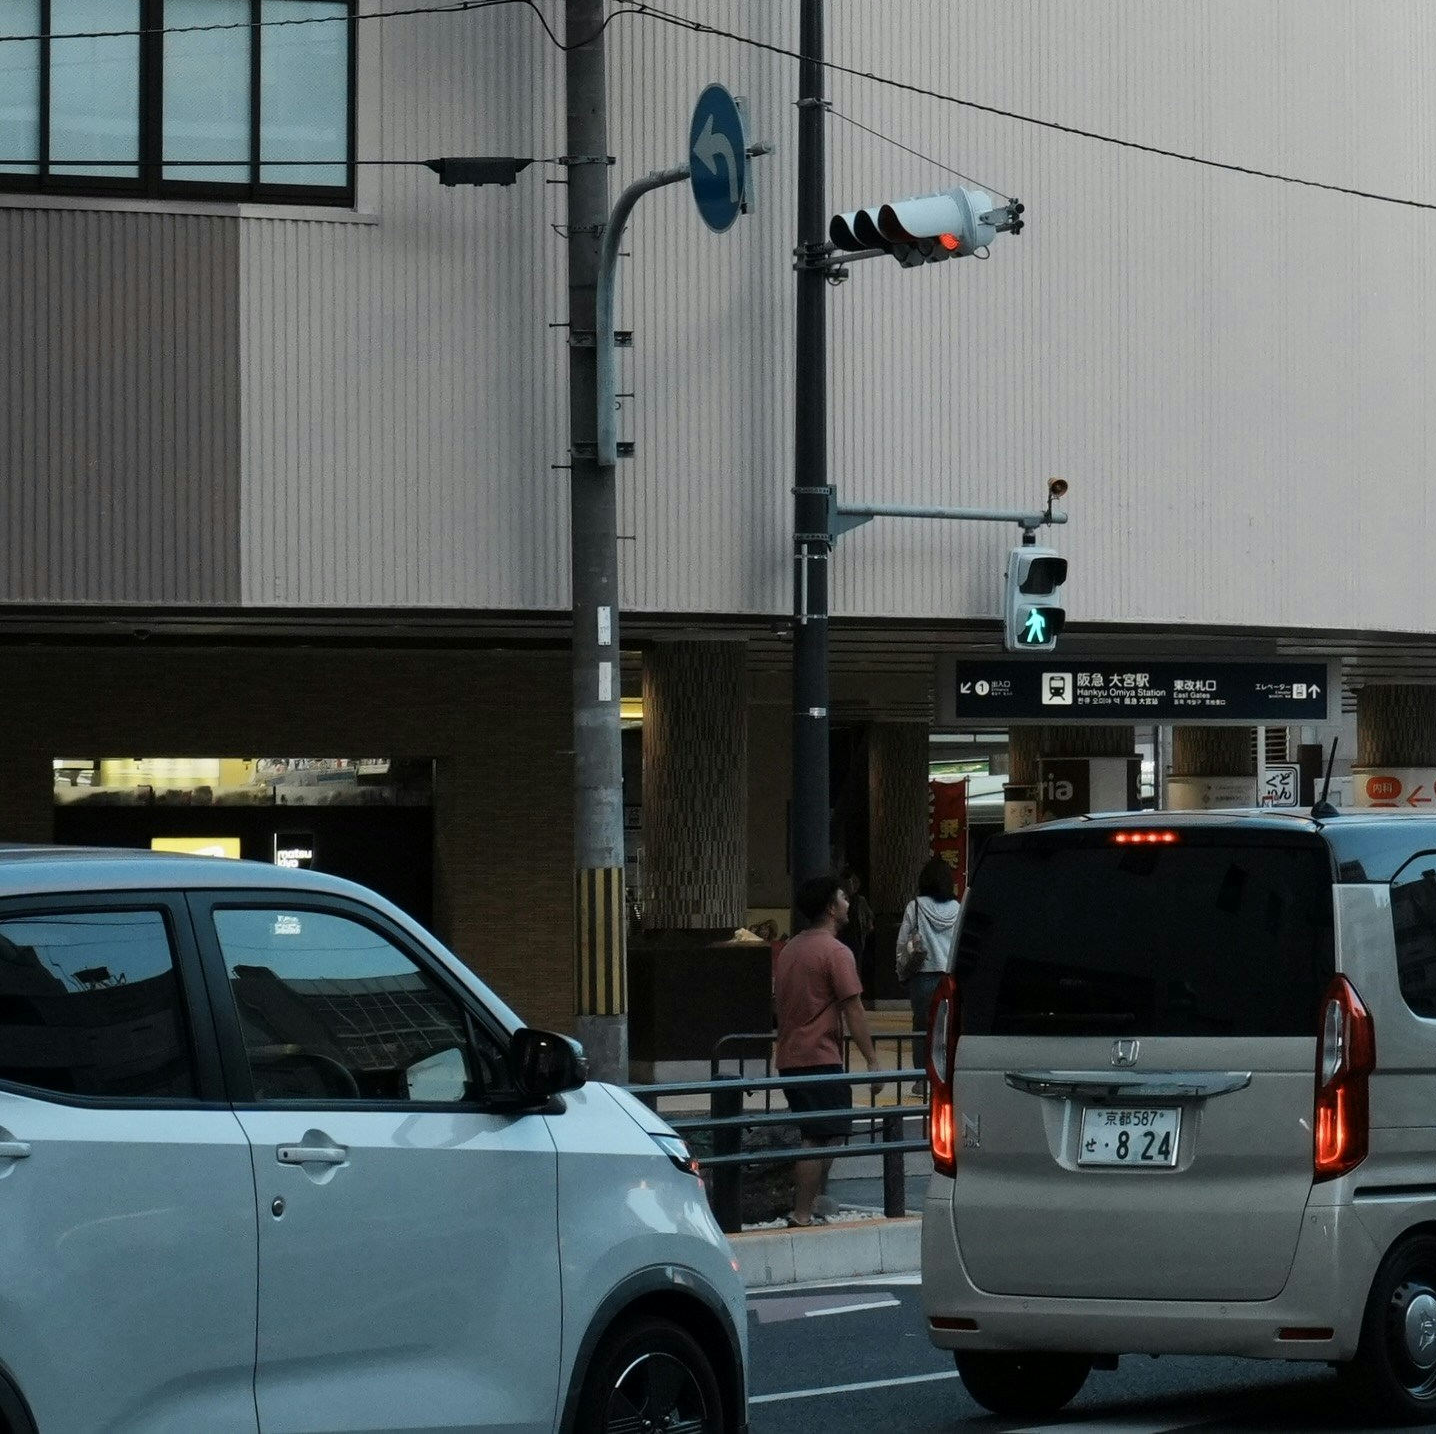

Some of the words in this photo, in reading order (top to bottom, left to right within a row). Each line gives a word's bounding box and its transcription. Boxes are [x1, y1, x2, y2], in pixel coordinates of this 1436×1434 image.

[1077, 672, 1104, 687] 阪急
[1109, 672, 1150, 687] 大宮駅
[1173, 679, 1217, 691] 東改札口
[1077, 688, 1107, 698] Hankyu
[1109, 688, 1136, 698] Omiya
[1137, 688, 1166, 697] Station
[1173, 691, 1189, 699] East
[1190, 691, 1211, 699] Gates
[1372, 782, 1393, 794] 内科
[277, 849, 312, 859] matsu
[1085, 1138, 1097, 1153] せ
